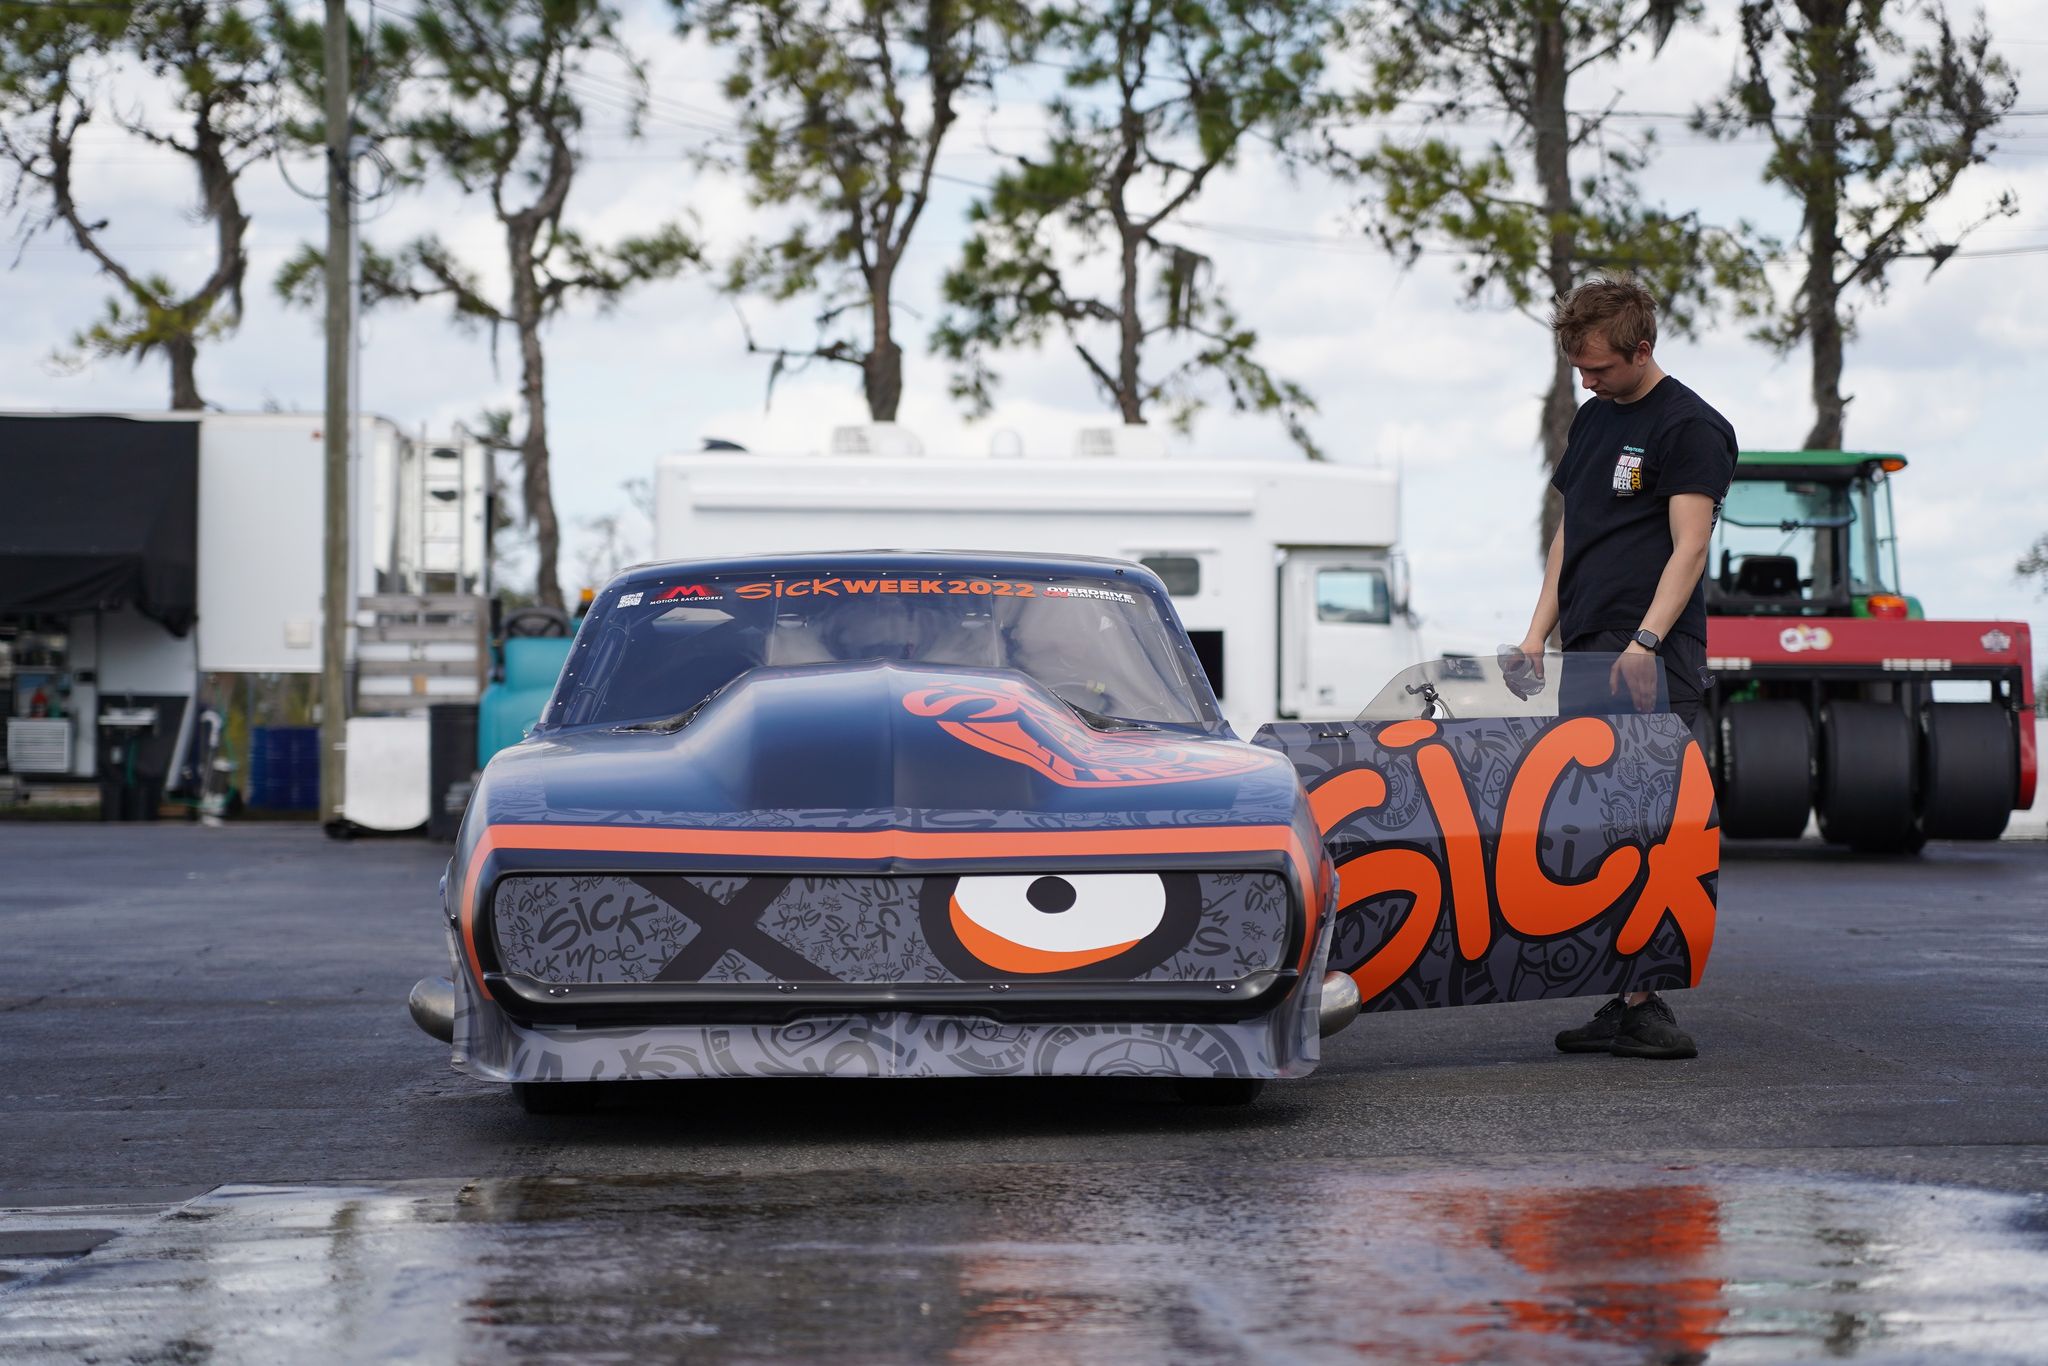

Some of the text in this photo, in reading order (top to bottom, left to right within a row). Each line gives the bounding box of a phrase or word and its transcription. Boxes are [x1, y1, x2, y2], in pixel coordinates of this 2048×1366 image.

[842, 580, 944, 594] WEEK
[947, 580, 1038, 598] 2022
[1047, 587, 1132, 600] OVERDRIVE
[1093, 594, 1136, 605] VENDORS
